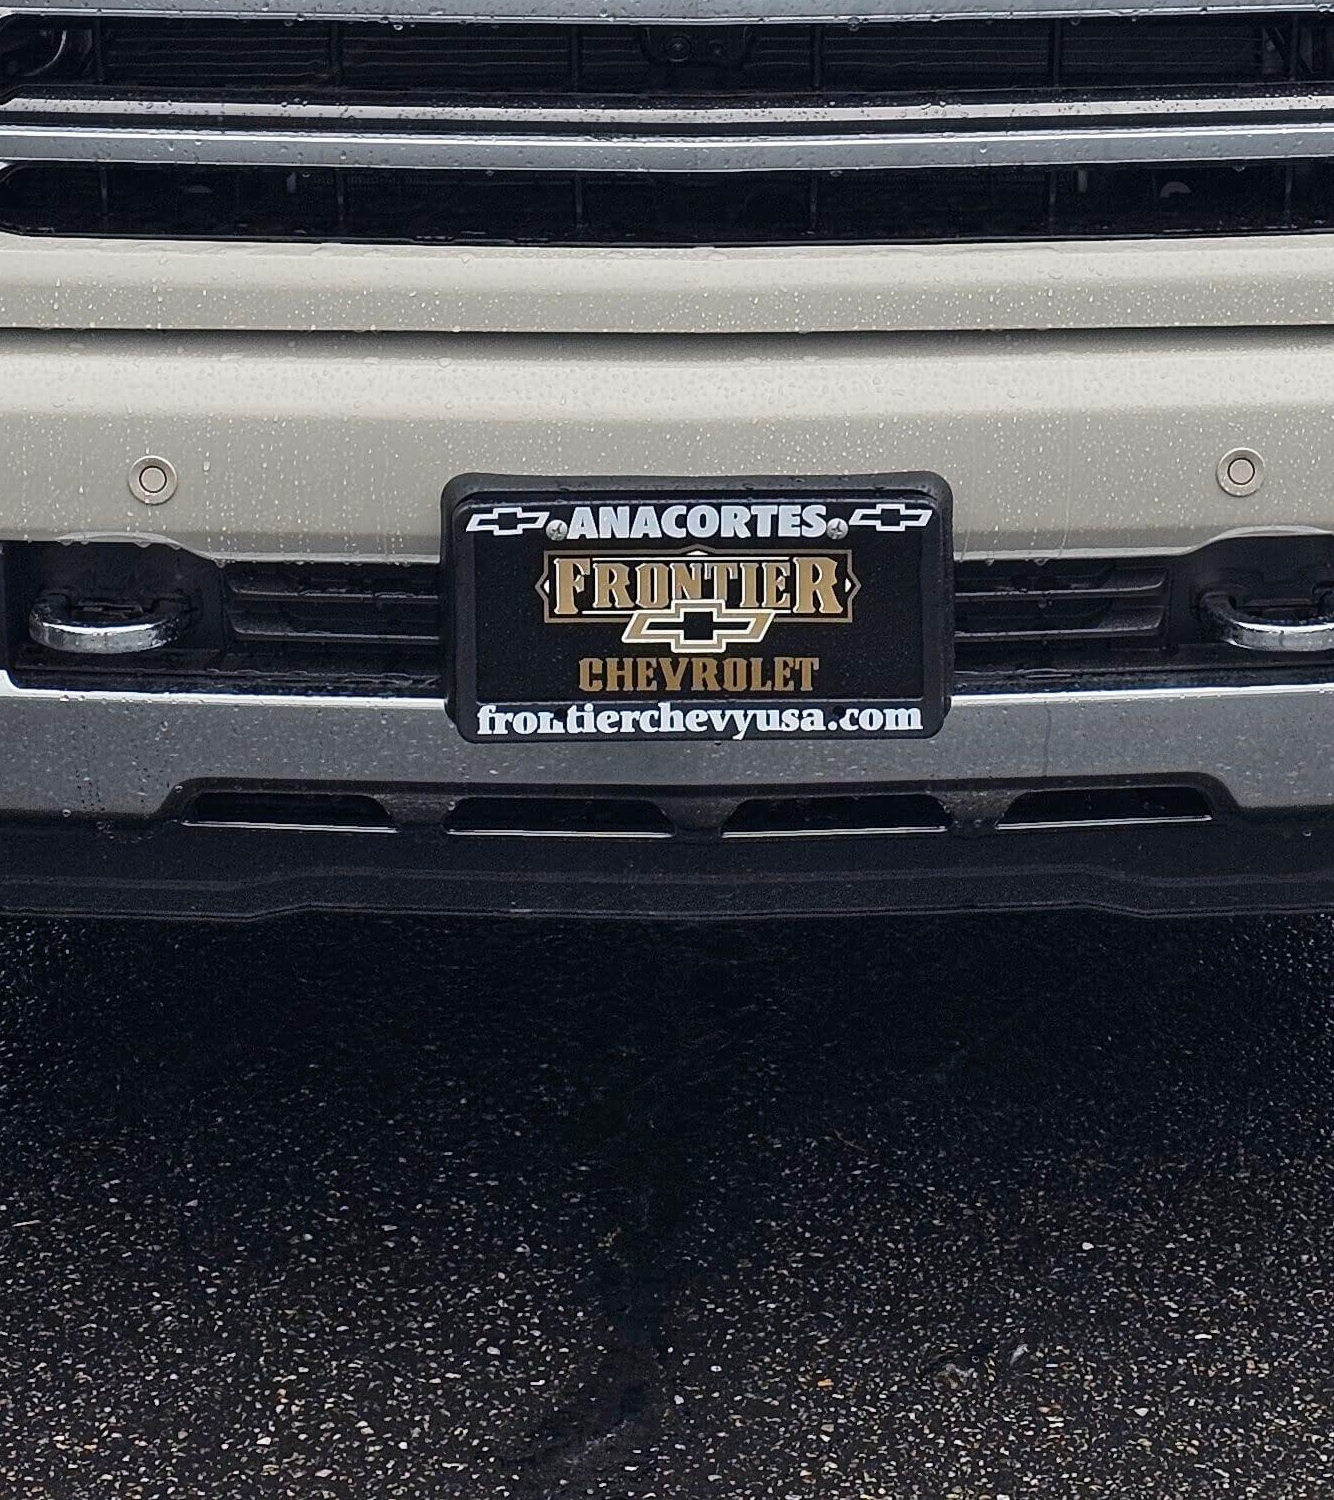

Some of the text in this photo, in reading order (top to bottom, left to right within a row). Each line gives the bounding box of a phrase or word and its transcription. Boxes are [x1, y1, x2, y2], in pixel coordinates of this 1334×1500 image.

[568, 504, 828, 539] ANACORTES
[553, 556, 845, 615] FRONTIER
[578, 656, 820, 693] CHEVROLET
